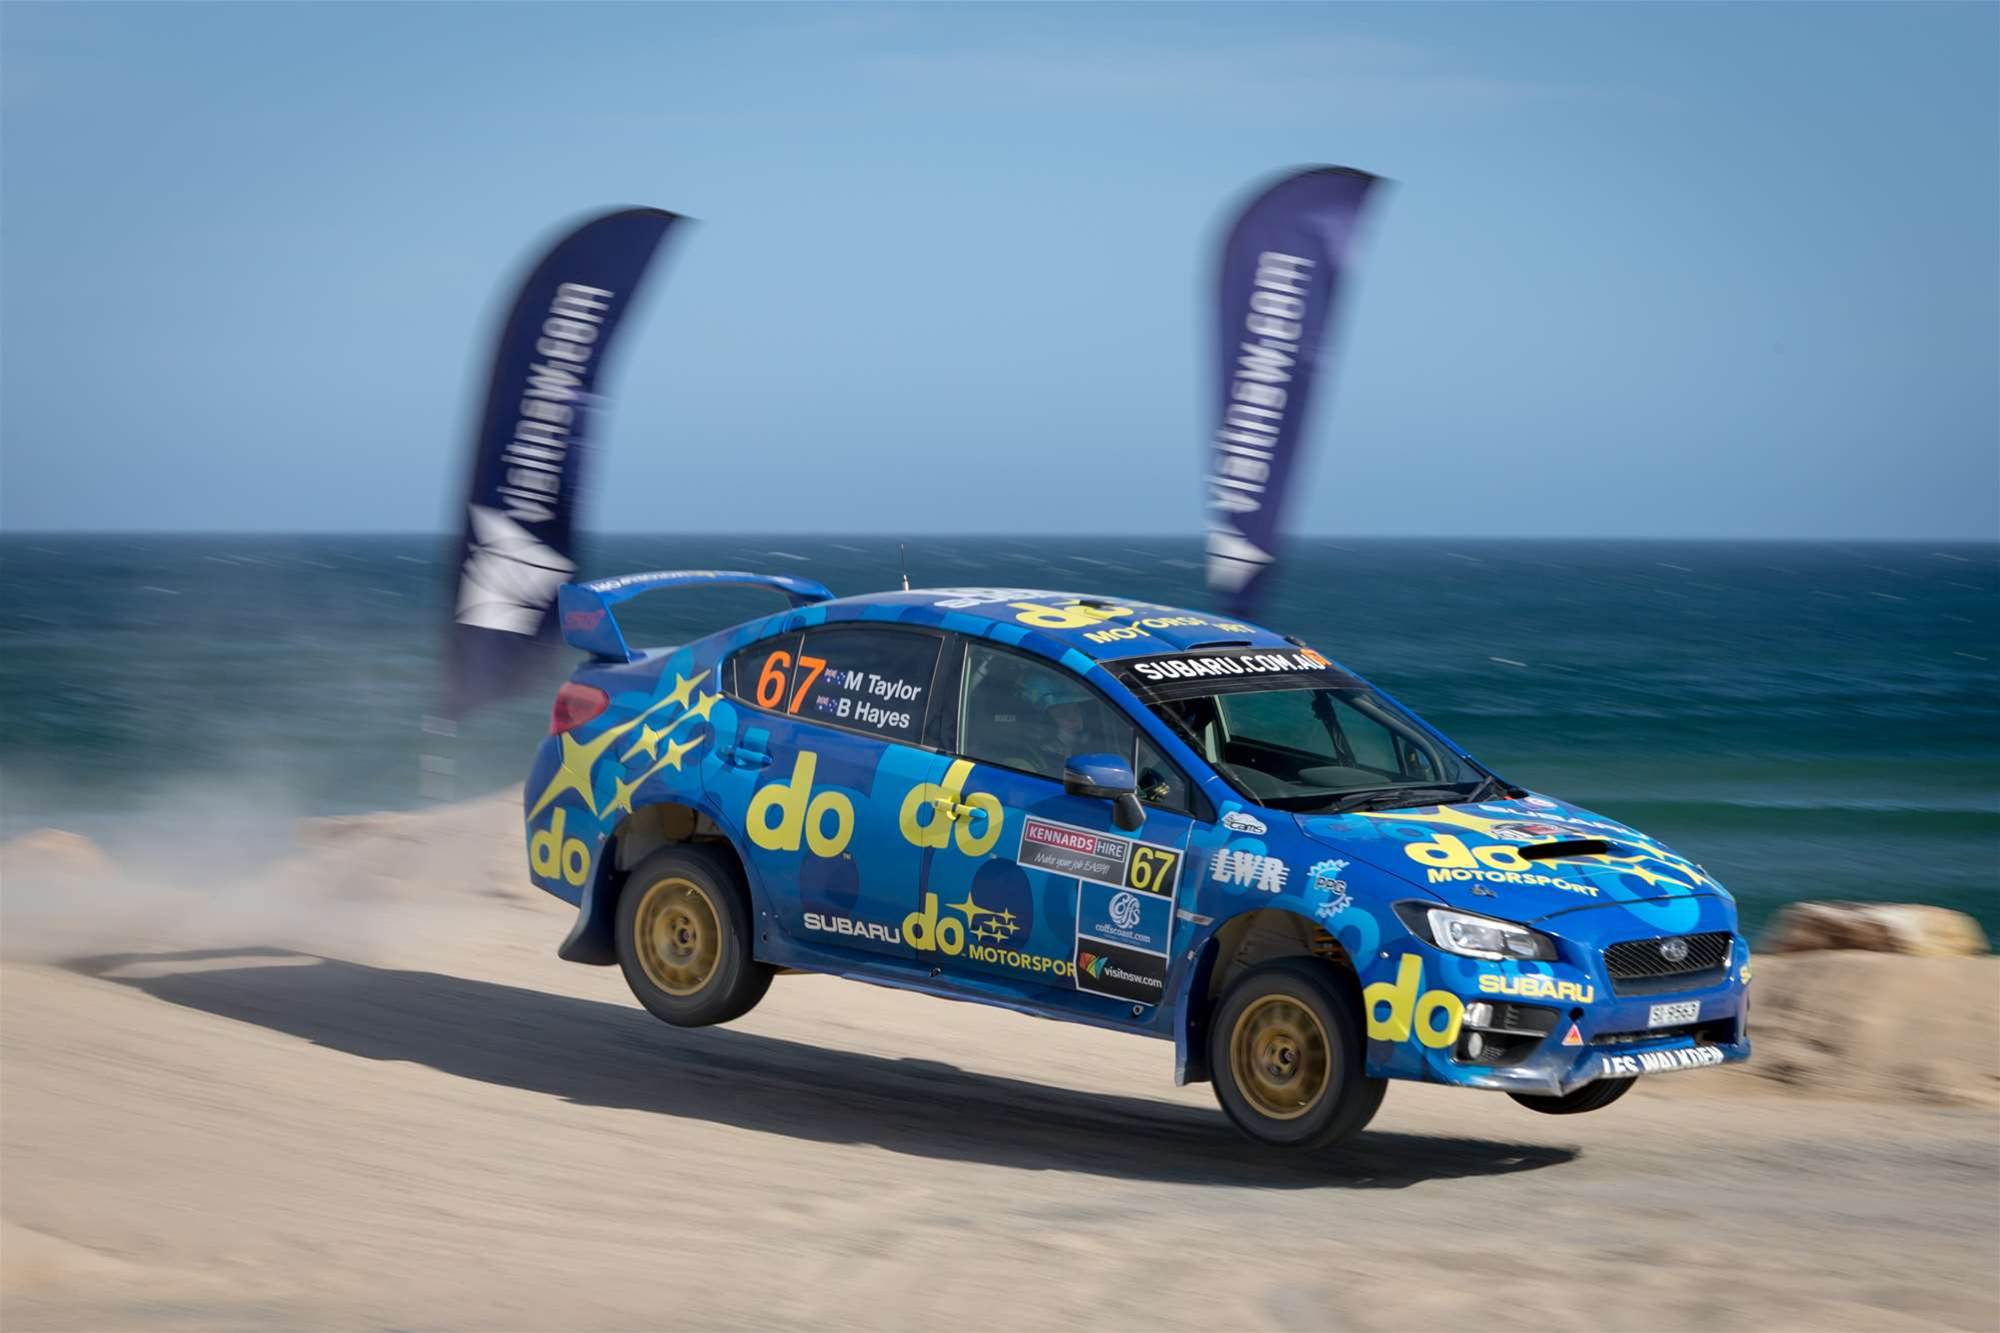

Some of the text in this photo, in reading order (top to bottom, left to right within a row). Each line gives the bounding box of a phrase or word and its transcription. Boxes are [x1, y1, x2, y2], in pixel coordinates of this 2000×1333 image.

[1006, 602, 1134, 629] do
[755, 650, 827, 714] 67
[844, 670, 922, 701] M Taylor
[1134, 653, 1326, 680] SUBARU.COM.AU
[836, 697, 910, 728] B Hayes
[746, 751, 855, 858] do
[899, 758, 1004, 857] do
[530, 807, 591, 886] do
[1028, 825, 1125, 859] KENNARDS HIRE
[1404, 834, 1532, 872] do
[1130, 847, 1175, 893] 67
[1209, 848, 1291, 893] LWR
[1427, 868, 1599, 897] MOTORSPORT
[803, 893, 1076, 978] SUBARU do MOTORSPOR
[1104, 966, 1163, 989] visitnsw.com
[1479, 974, 1595, 1004] SUBARU
[1363, 953, 1466, 1049] do
